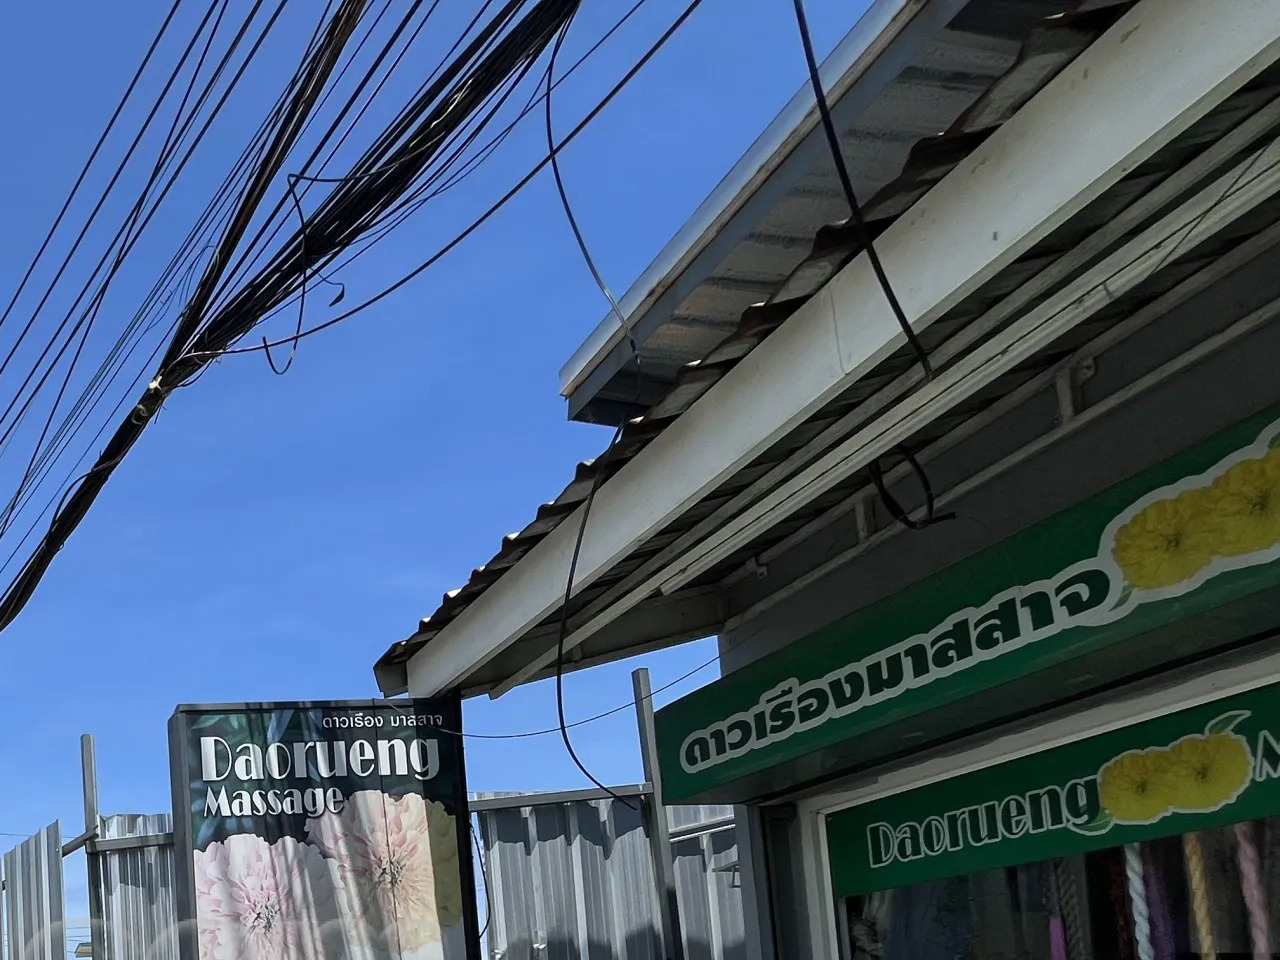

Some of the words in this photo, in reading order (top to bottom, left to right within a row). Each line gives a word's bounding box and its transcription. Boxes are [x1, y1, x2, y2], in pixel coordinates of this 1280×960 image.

[322, 712, 384, 728] ดาวเรือง
[200, 735, 440, 782] Daorueng
[204, 785, 345, 818] Massage
[867, 776, 1101, 868] Daorueng
